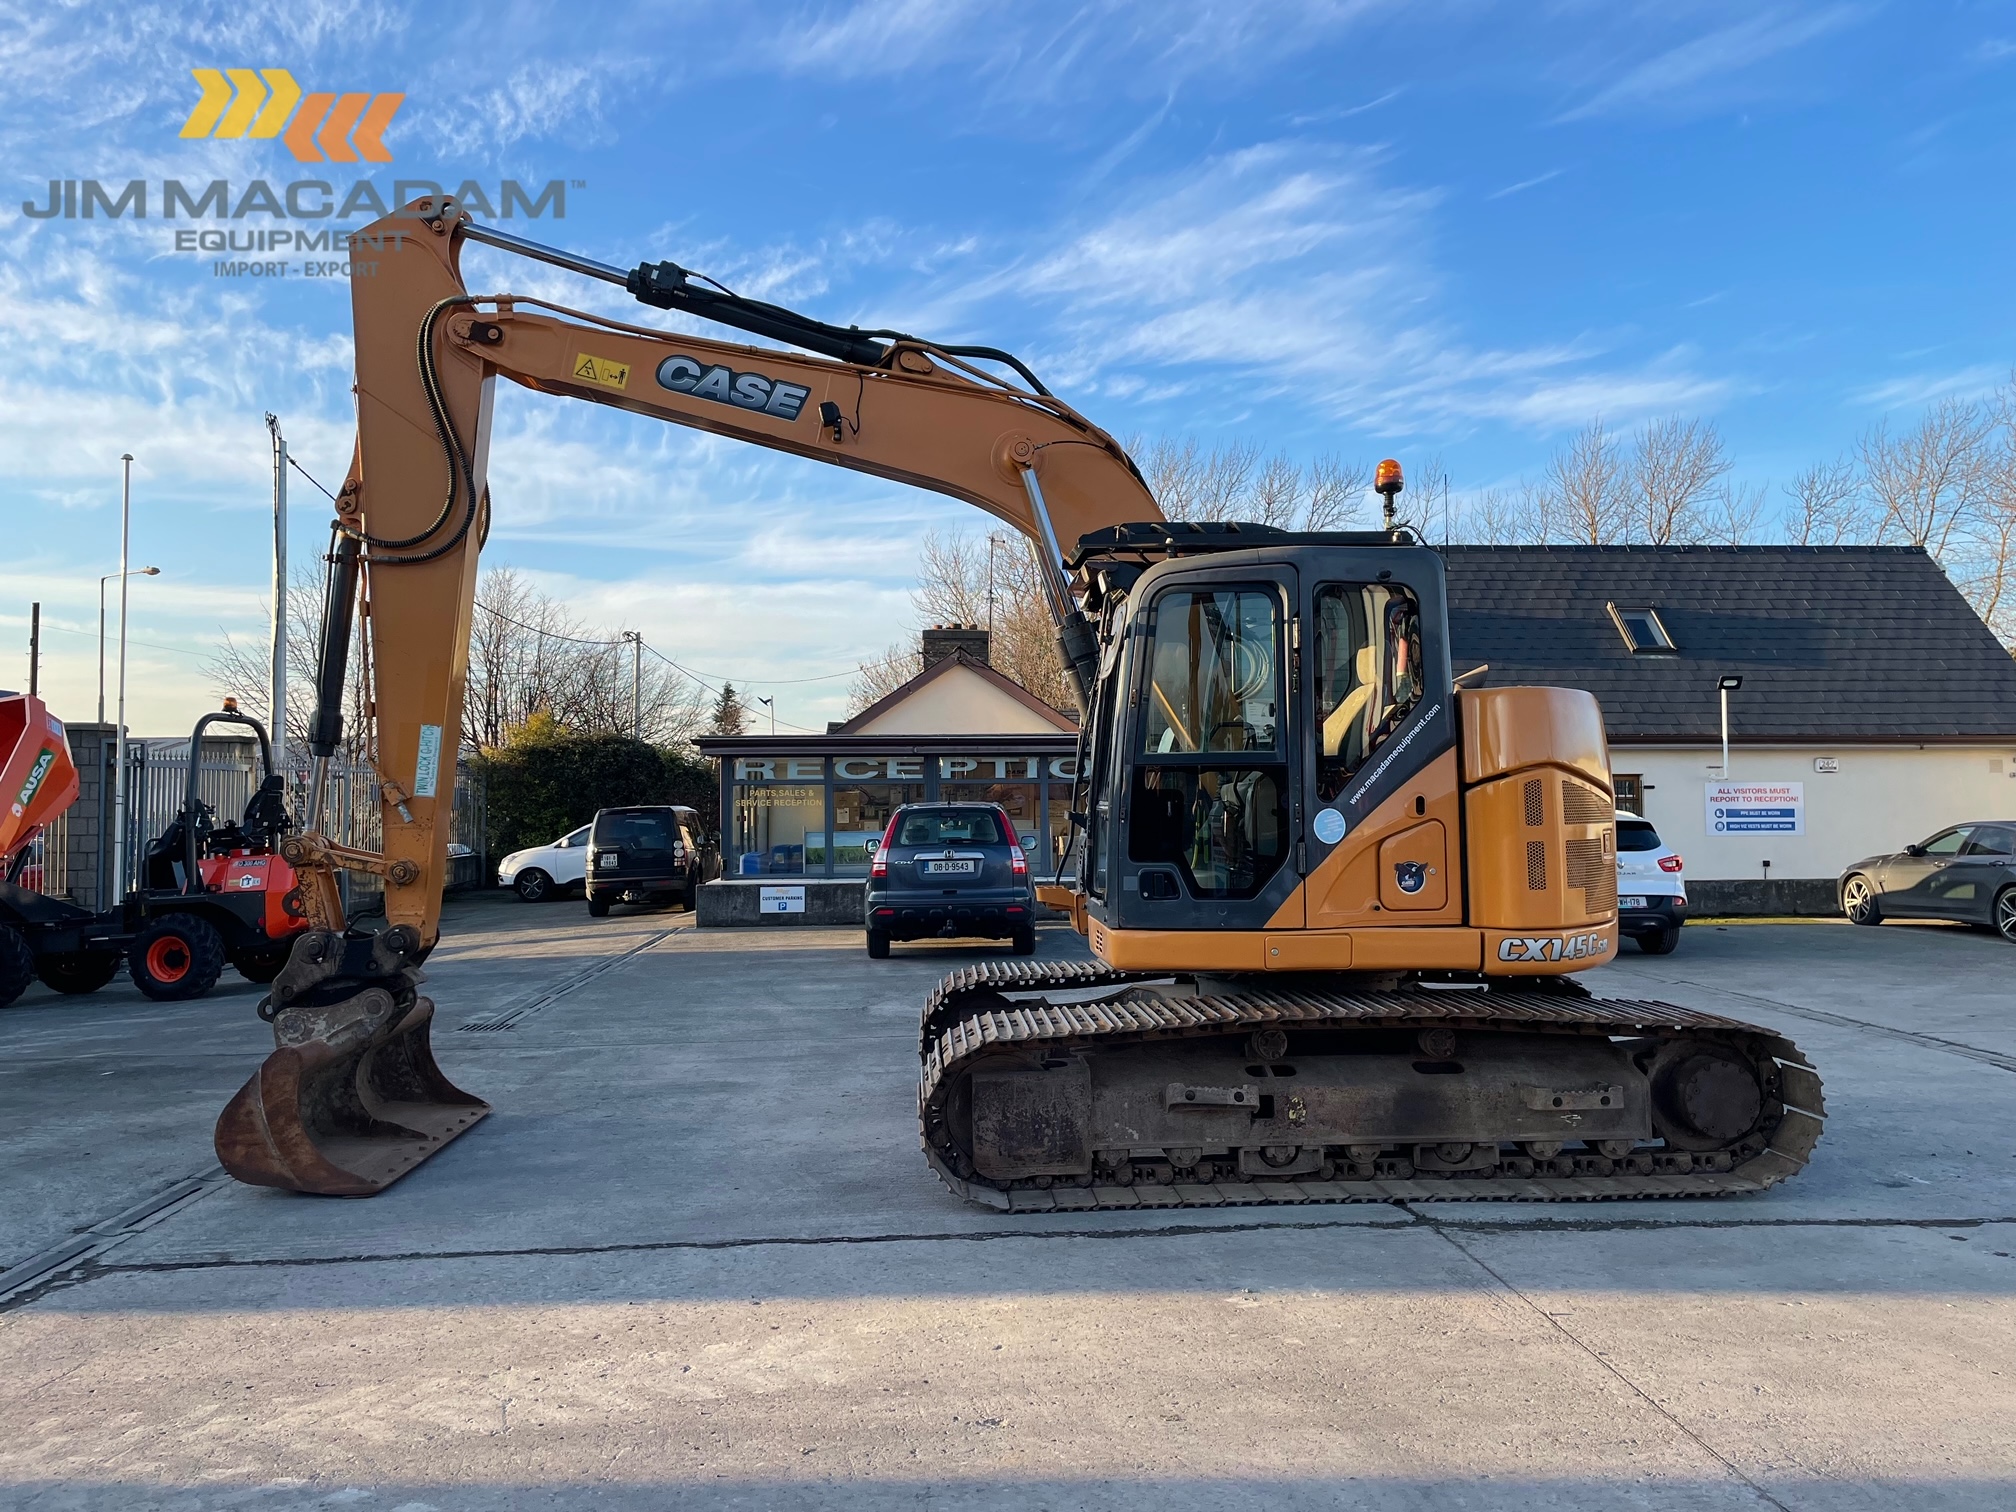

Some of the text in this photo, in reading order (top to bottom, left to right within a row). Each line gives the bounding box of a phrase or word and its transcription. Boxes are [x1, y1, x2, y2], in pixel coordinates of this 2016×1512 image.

[657, 356, 809, 417] CASE
[419, 756, 431, 775] LOCK
[1349, 703, 1441, 805] www.macadamequipment.com
[20, 754, 53, 804] AUSA
[734, 757, 1091, 780] RECEPTIO
[416, 777, 428, 794] TWIN
[808, 789, 815, 797] &
[735, 799, 822, 807] SERVICE RECEPTION
[1498, 932, 1599, 962] CX145C
